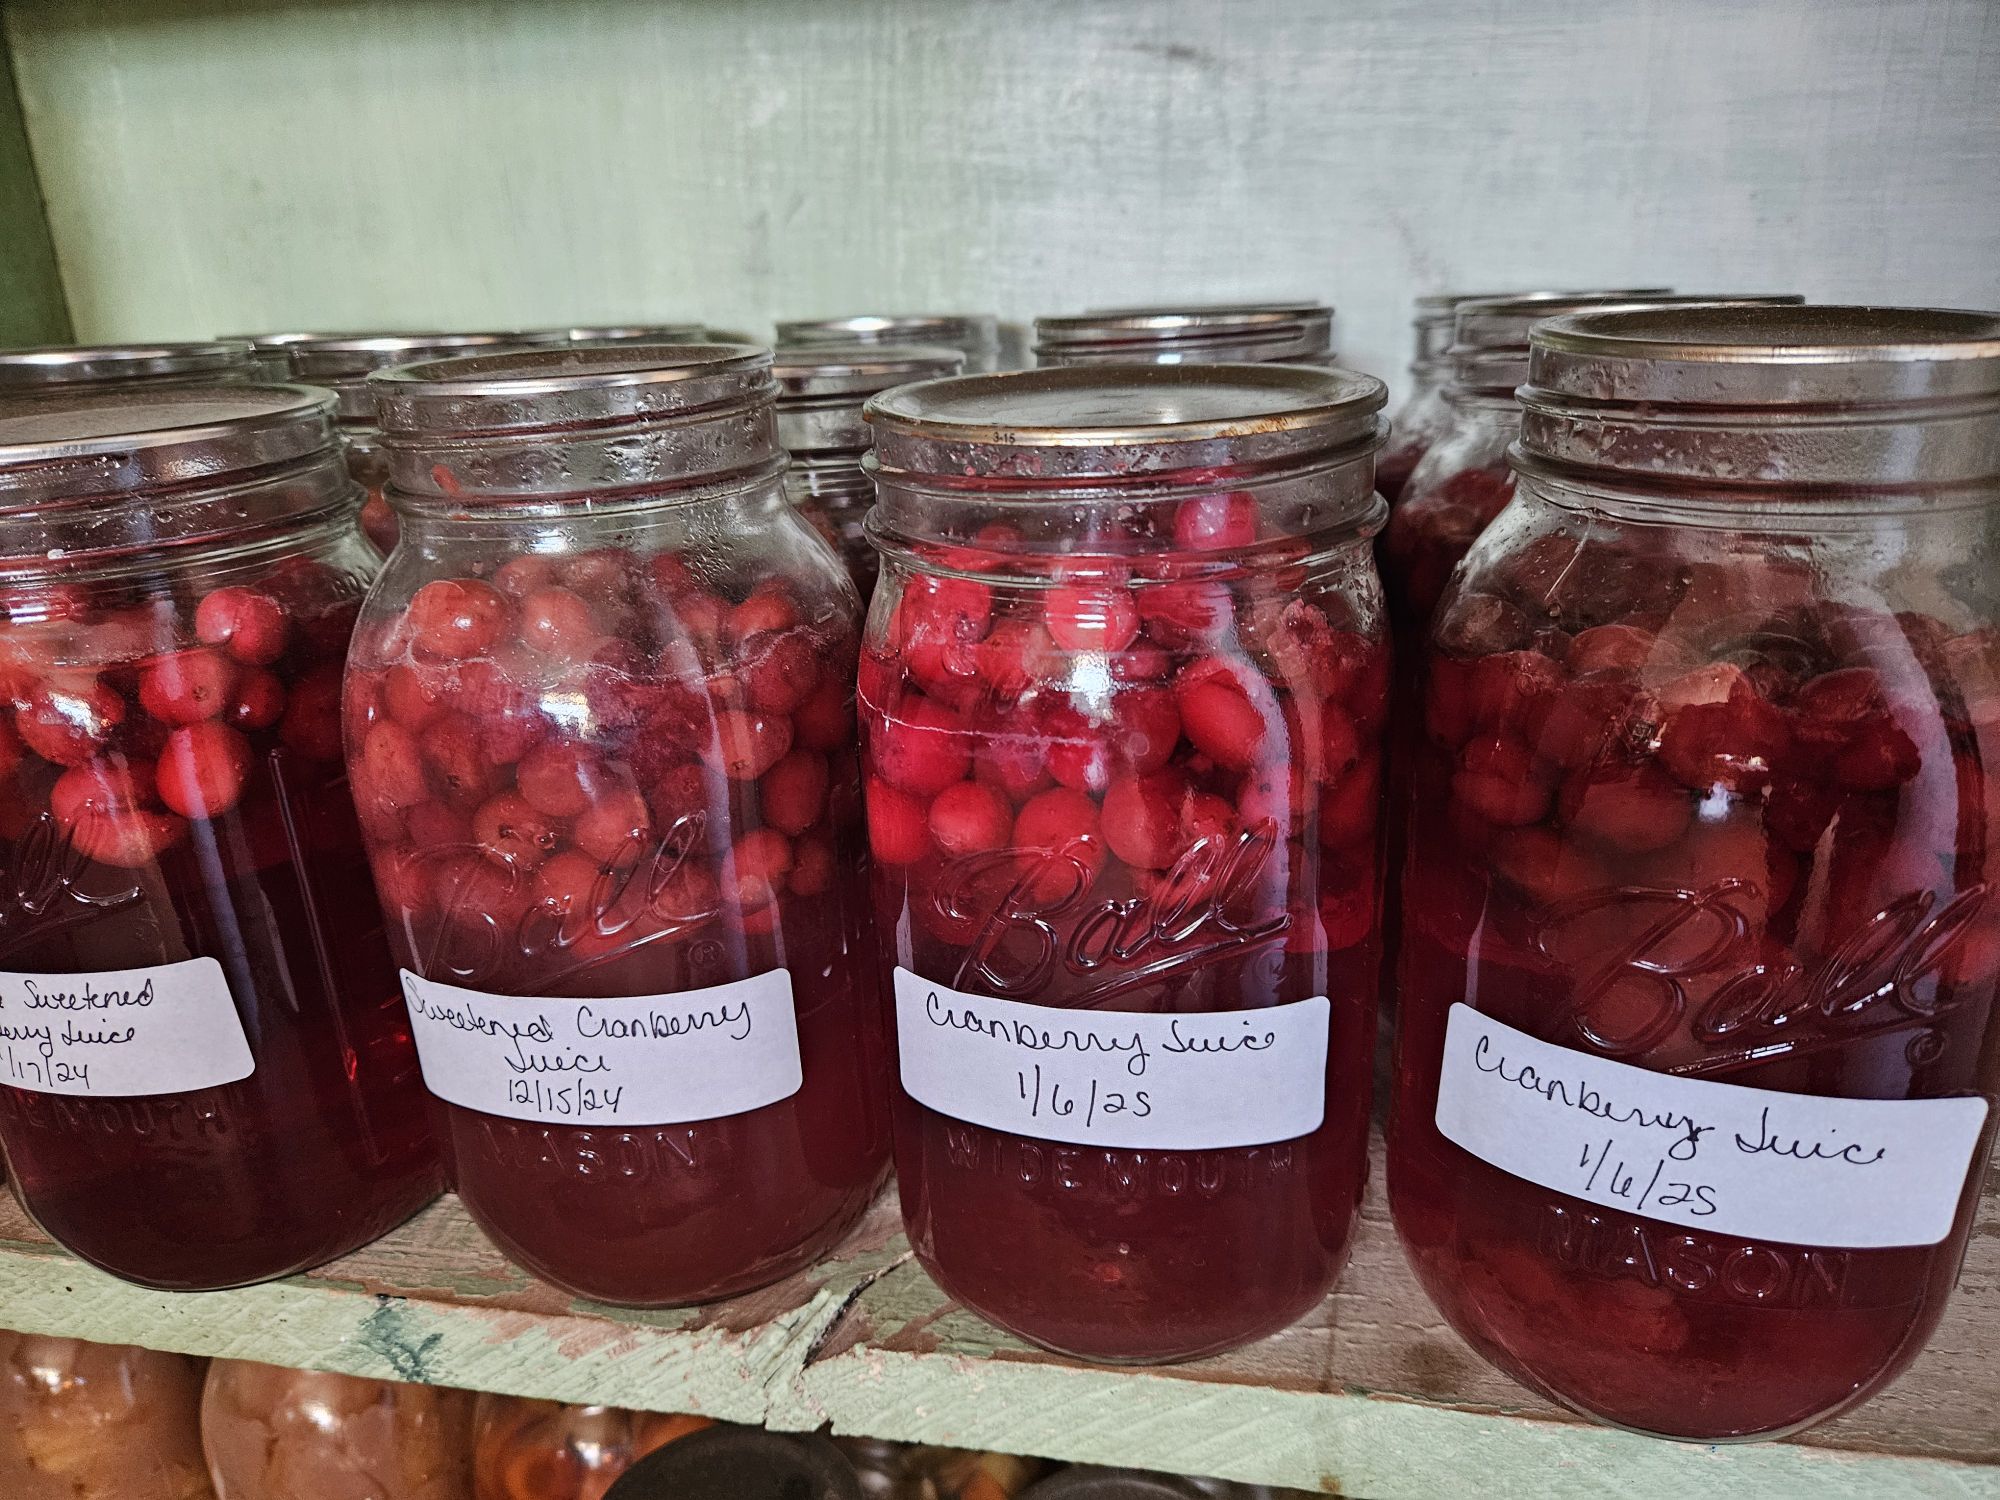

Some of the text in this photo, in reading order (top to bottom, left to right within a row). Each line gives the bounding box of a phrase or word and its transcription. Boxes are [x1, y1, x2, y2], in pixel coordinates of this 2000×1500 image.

[395, 810, 721, 982] Ball
[933, 816, 1293, 992] Ball
[24, 978, 154, 1011] Sweetened
[1528, 877, 1987, 1054] Ball
[0, 1025, 53, 1058] erry
[576, 1001, 751, 1041] Cranberry
[926, 991, 1150, 1076] Cranberry
[0, 1045, 90, 1089] /17/24
[508, 1078, 624, 1116] 12/15/24
[1018, 1064, 1152, 1128] 1/6/25
[1475, 1035, 1716, 1161] Cranberry
[946, 1126, 1294, 1195] WIDE MOUTH
[1579, 1139, 1718, 1217] 1/6/25
[1538, 1203, 1853, 1302] MASON
